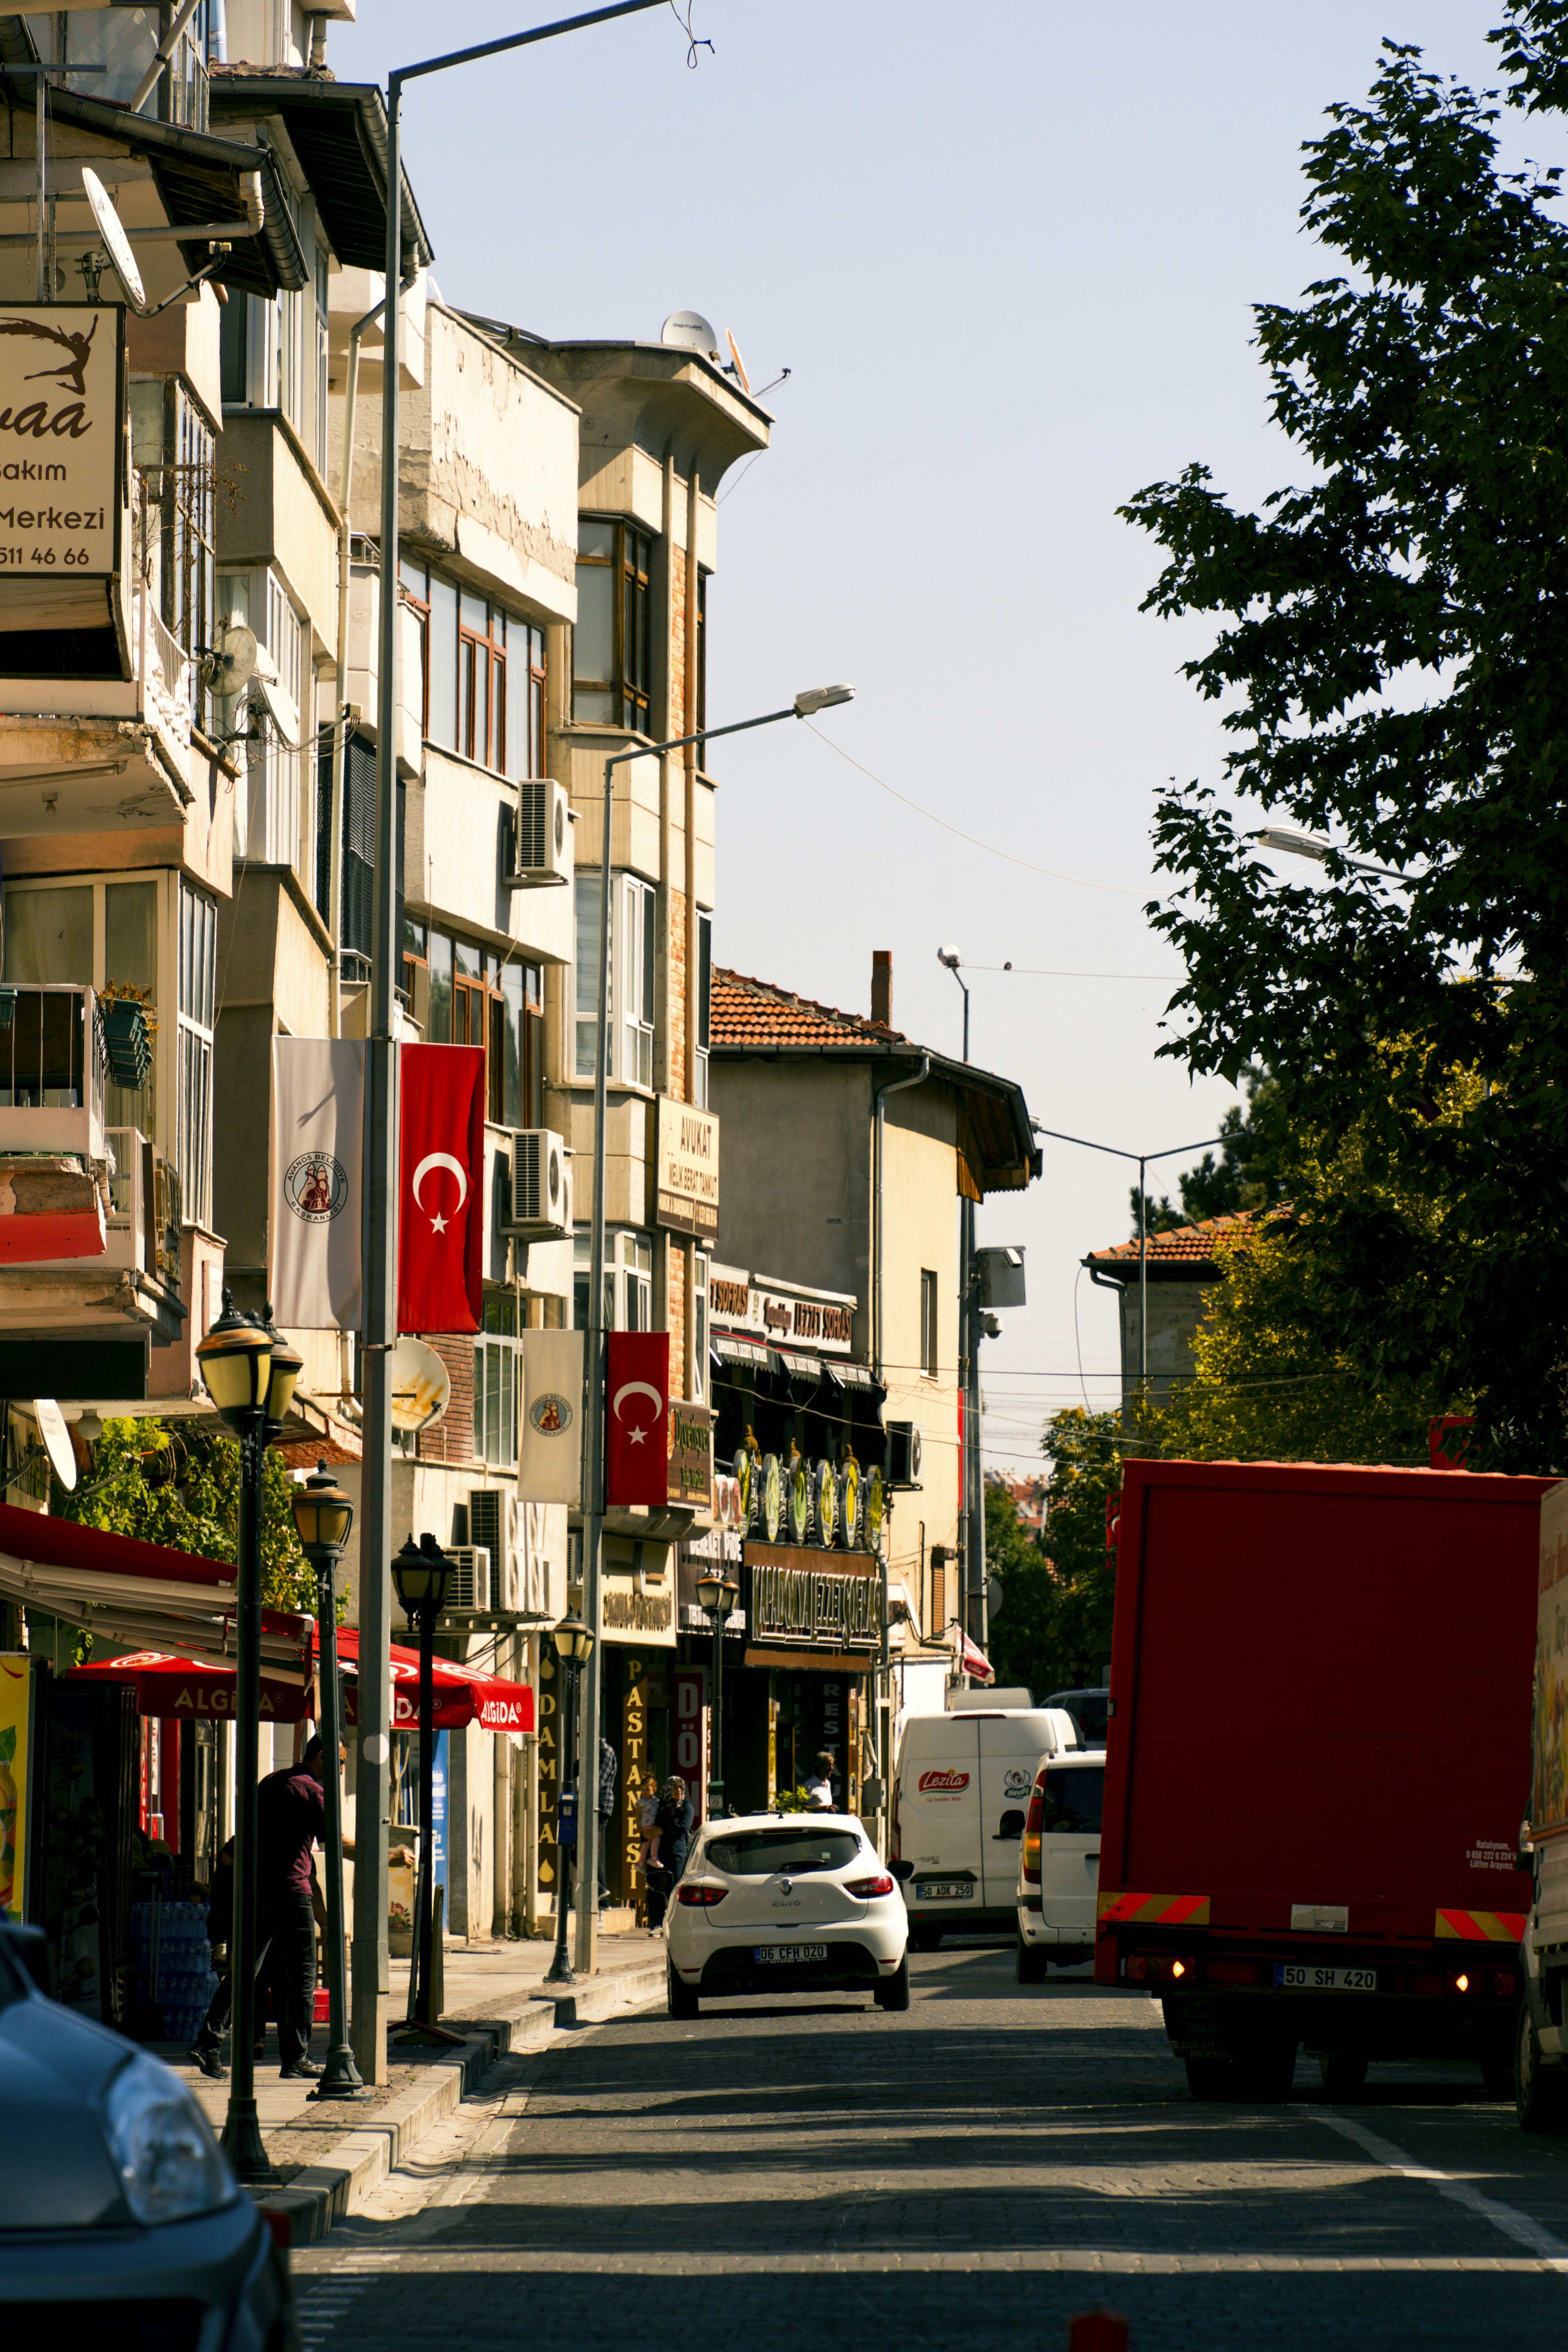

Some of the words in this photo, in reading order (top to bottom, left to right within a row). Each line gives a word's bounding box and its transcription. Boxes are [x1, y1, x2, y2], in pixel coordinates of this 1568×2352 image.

[0, 460, 66, 481] akım
[31, 548, 56, 565] 46
[64, 548, 89, 565] 66
[681, 1116, 711, 1160] AVUKAT
[287, 1154, 312, 1181] AVANOS
[315, 1154, 345, 1184] BELEDİYE
[684, 1167, 699, 1194] BERAT
[700, 1171, 717, 1199] TANKUT
[291, 1201, 341, 1221] BAŞKANLIĞI
[822, 1306, 852, 1342] SOFRASI
[174, 1688, 274, 1713] ALGiA
[538, 1693, 557, 1844] DAMLA
[923, 1771, 965, 1788] Lezita
[1466, 1849, 1470, 1859] 0
[1471, 1850, 1483, 1859] 850
[1483, 1851, 1494, 1860] 222
[1495, 1851, 1500, 1860] 0
[1475, 1839, 1510, 1852] Hatalıysam,
[1469, 1858, 1489, 1869] Lütfen
[1489, 1860, 1515, 1871] Arayınız.
[922, 1887, 932, 1896] 50
[936, 1886, 951, 1896] ADK
[955, 1885, 970, 1895] 250
[760, 1948, 774, 1960] 06
[779, 1947, 800, 1959] CFH
[804, 1945, 824, 1958] 020
[1286, 1968, 1306, 1984] 50
[1315, 1970, 1335, 1986] SH
[1344, 1971, 1374, 1989] 420
